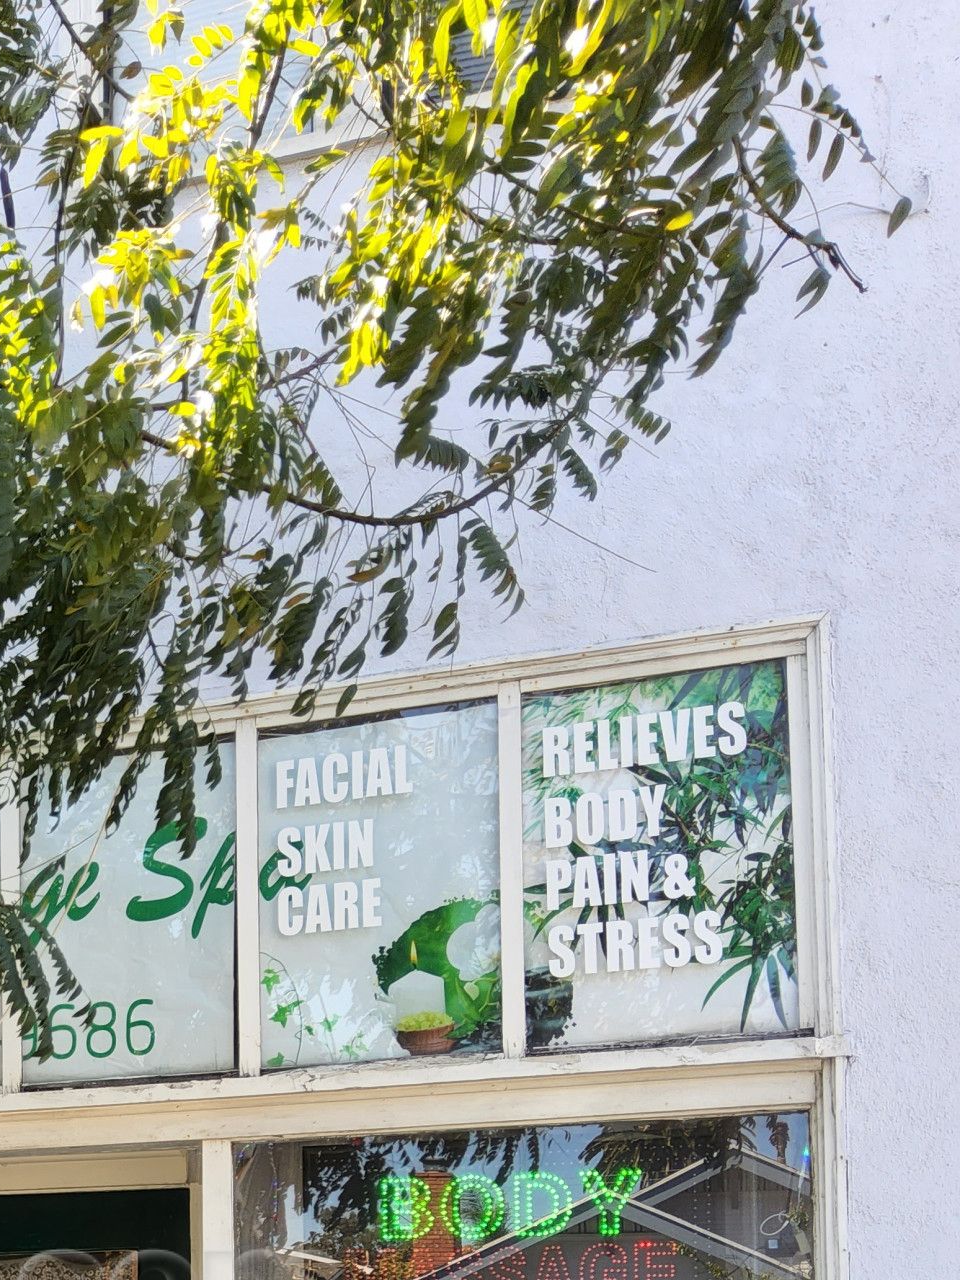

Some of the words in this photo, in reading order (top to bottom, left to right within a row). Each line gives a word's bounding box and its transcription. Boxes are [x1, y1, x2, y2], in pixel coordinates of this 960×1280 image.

[542, 701, 747, 777] RELIEVES
[275, 745, 414, 810] FACIAL
[277, 820, 375, 878] SKIN
[544, 784, 666, 849] BODY
[277, 878, 382, 936] CARE
[545, 850, 650, 911] PAIN
[663, 854, 697, 899] &
[548, 911, 725, 978] STRESS
[378, 1167, 642, 1240] BODY
